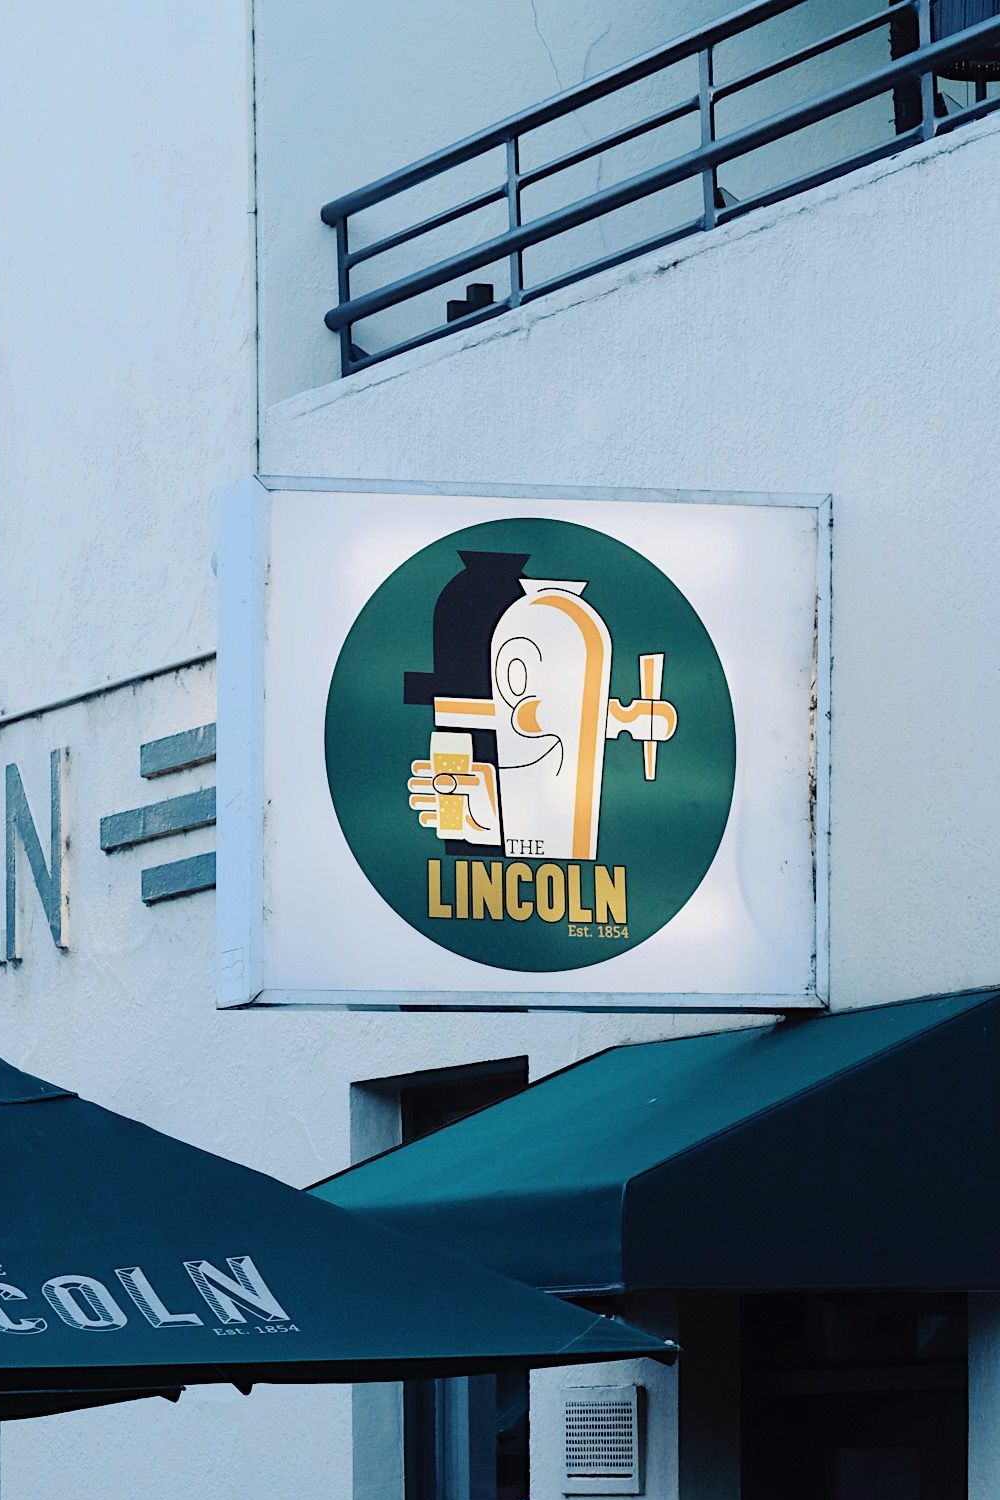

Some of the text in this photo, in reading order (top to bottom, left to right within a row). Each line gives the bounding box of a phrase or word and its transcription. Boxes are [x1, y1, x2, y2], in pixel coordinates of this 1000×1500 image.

[507, 839, 545, 855] THE
[427, 858, 628, 924] LINCOLN
[567, 925, 629, 939] Est. 1854
[213, 1324, 302, 1336] Est. 1854
